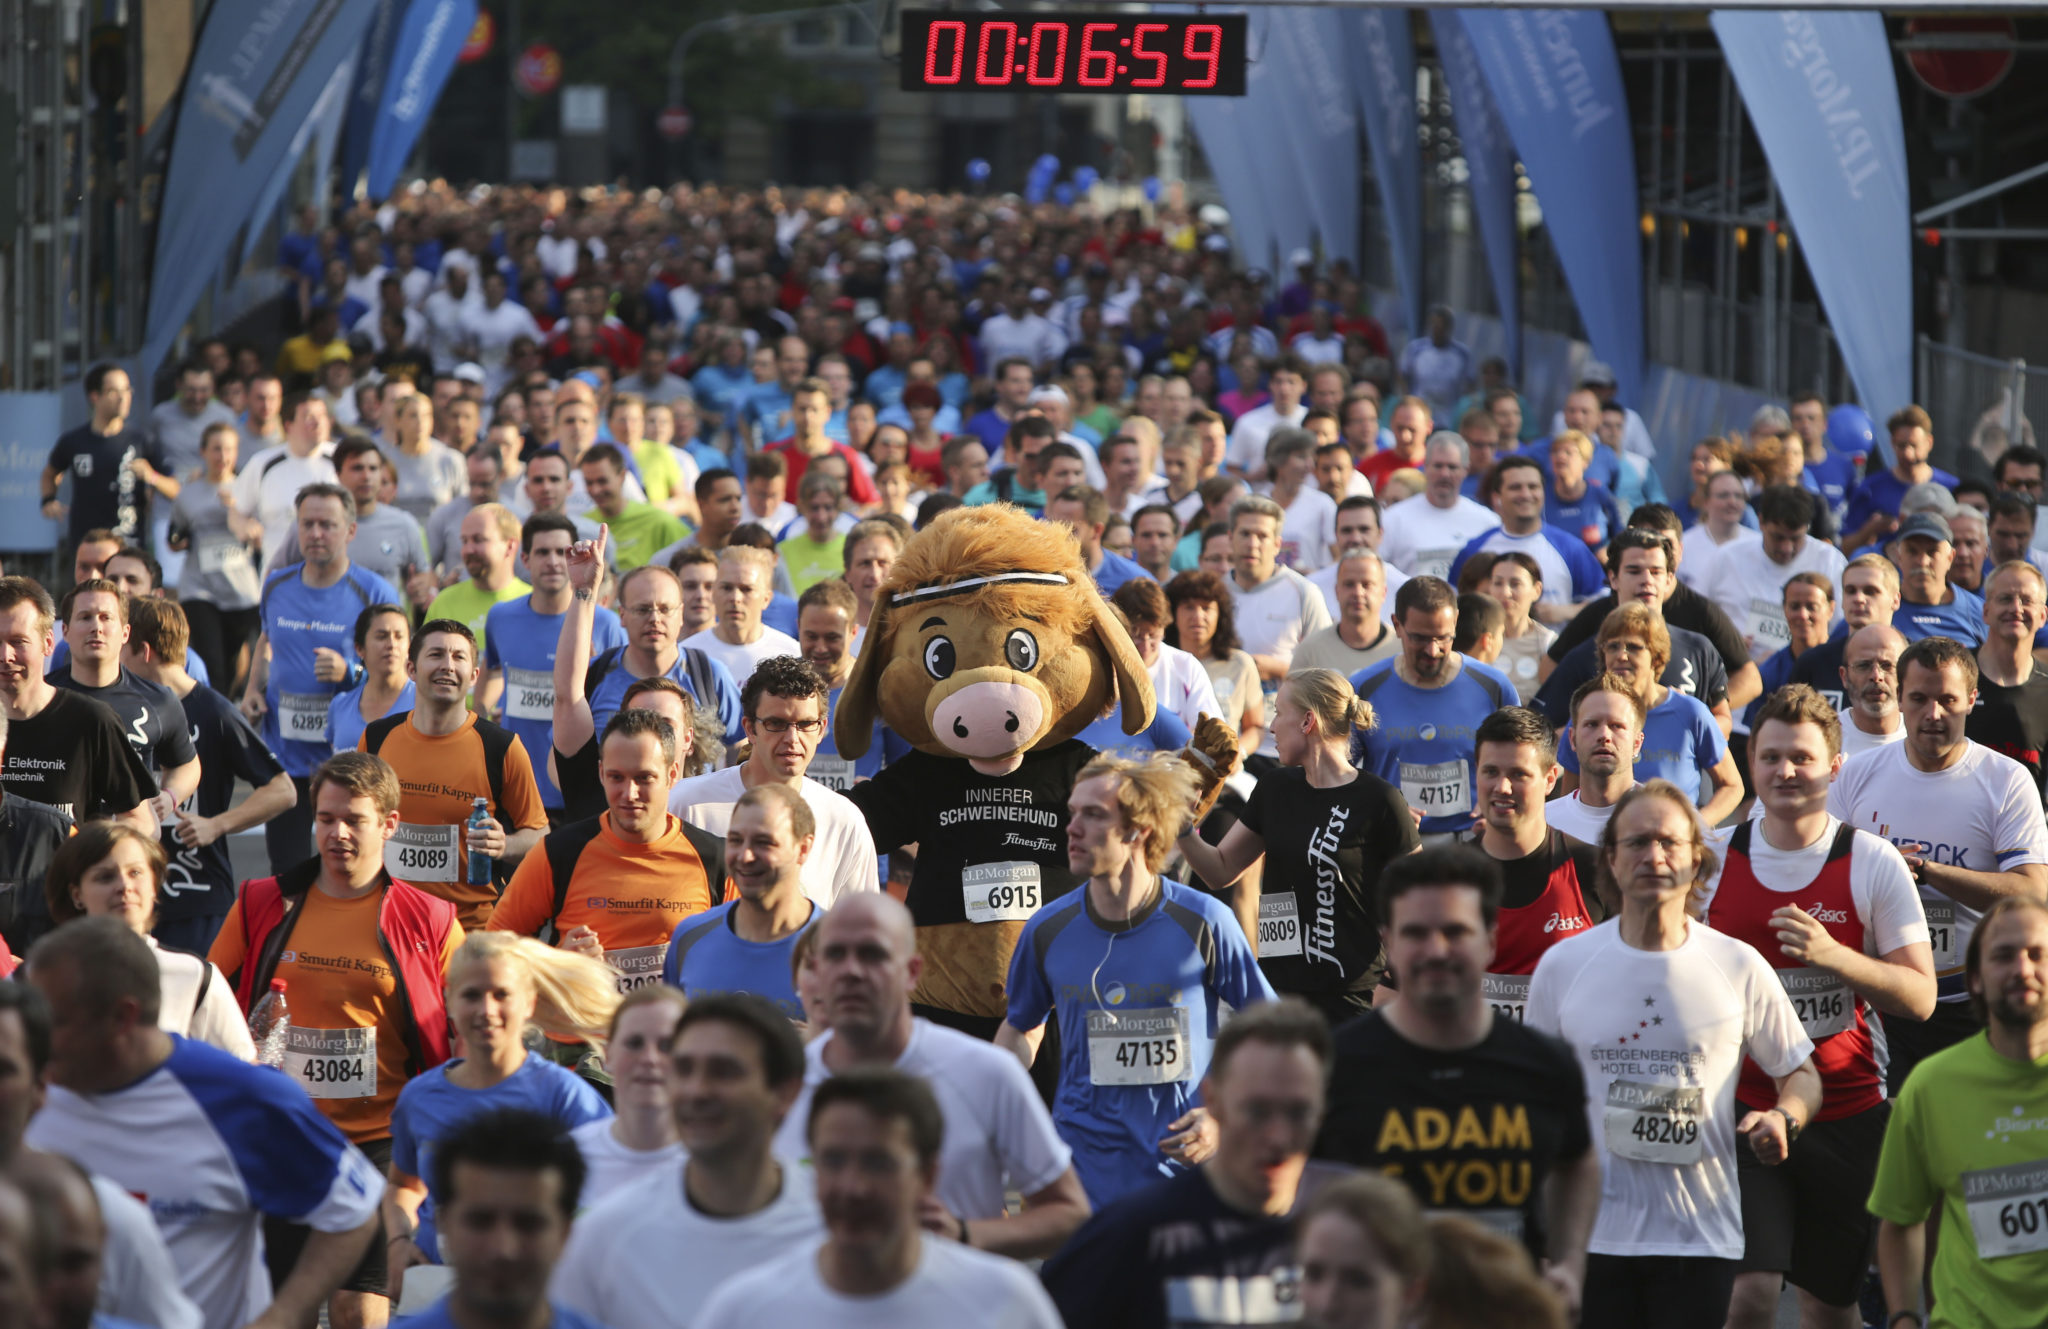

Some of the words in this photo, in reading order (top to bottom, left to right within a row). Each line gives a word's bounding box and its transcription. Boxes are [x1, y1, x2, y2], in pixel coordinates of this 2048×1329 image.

[923, 20, 1222, 88] 00:06:59
[8, 757, 67, 770] Elektronik
[965, 788, 1032, 804] INNERER
[1419, 783, 1461, 804] 47137
[939, 806, 1058, 828] SCHWEINEHUND
[399, 847, 448, 869] 43089
[965, 866, 1036, 881] J.P.Morgan
[607, 897, 653, 909] Smurfit
[656, 898, 692, 912] Kappa
[988, 886, 1038, 909] 6915
[299, 952, 352, 968] Smurfit
[1116, 1039, 1178, 1067] 47135
[1591, 1048, 1707, 1065] STEIGENBERGER
[303, 1058, 364, 1082] 43084
[1601, 1063, 1645, 1075] HOTEL
[1377, 1104, 1532, 1152] ADAM
[1632, 1115, 1698, 1145] 48209
[1423, 1159, 1531, 1205] YOU
